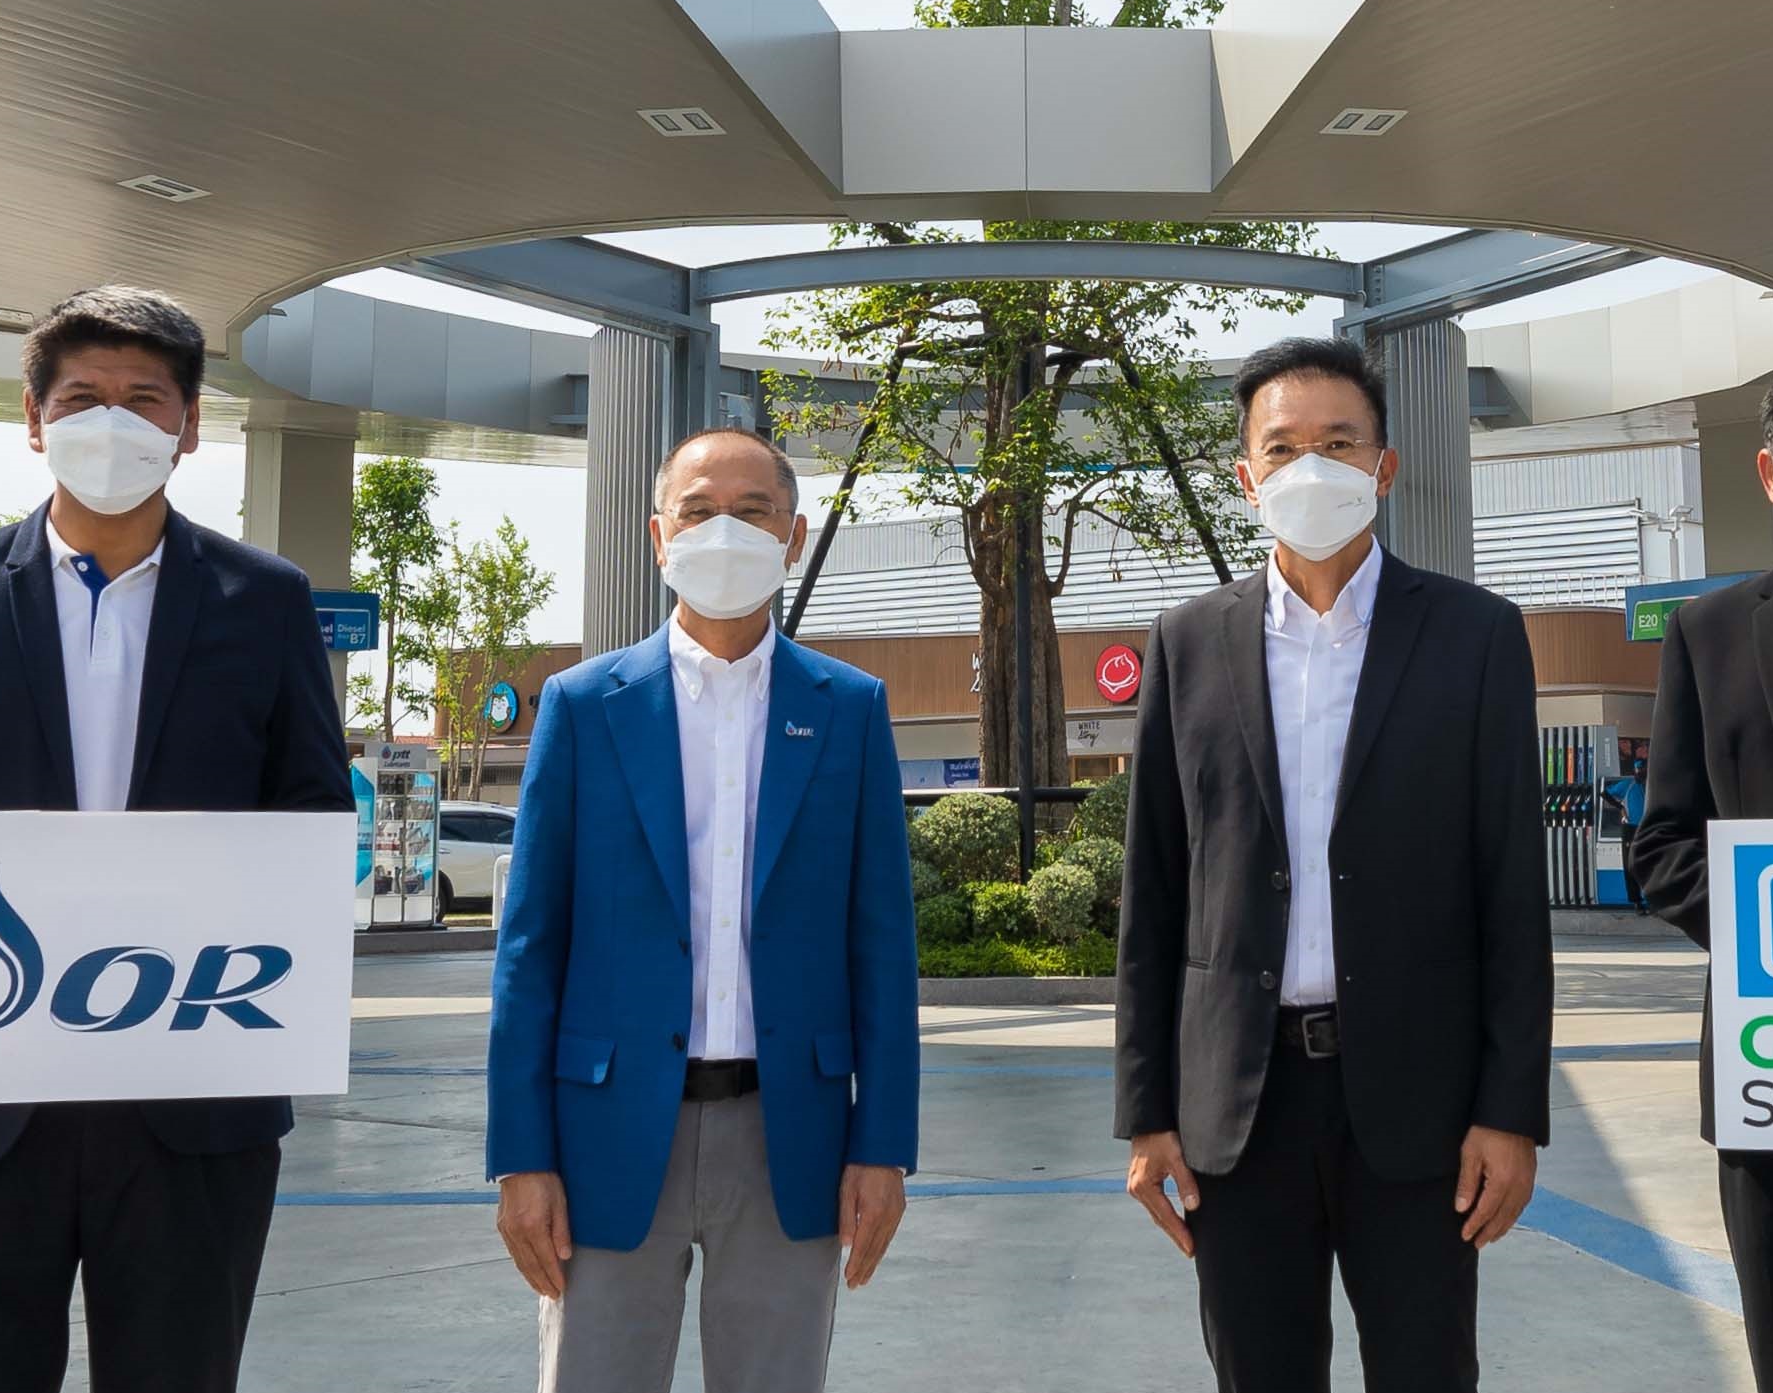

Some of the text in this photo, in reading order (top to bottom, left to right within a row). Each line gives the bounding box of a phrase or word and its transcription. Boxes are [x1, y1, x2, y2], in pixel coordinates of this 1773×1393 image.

[1638, 613, 1658, 628] E20
[337, 623, 366, 633] Diesel
[350, 633, 366, 644] B7
[49, 944, 293, 1032] OR
